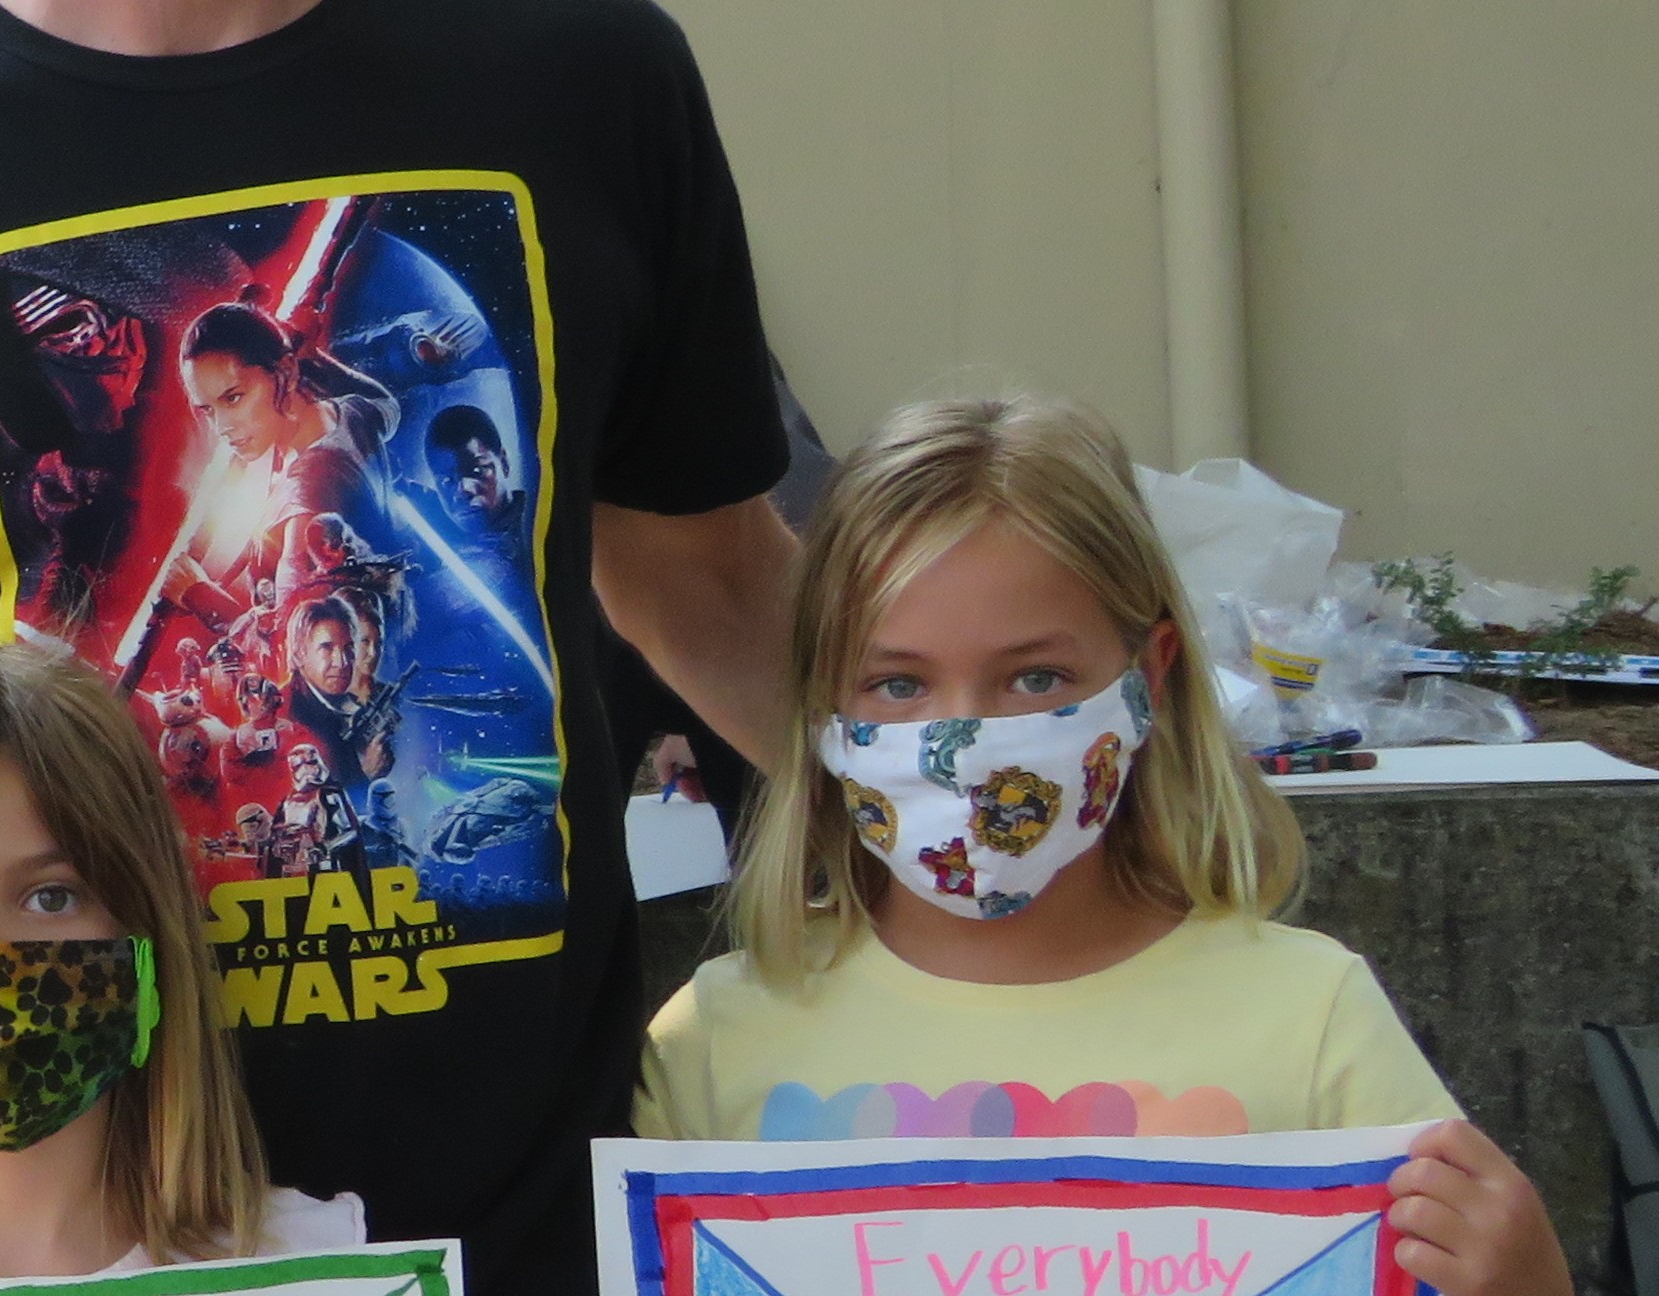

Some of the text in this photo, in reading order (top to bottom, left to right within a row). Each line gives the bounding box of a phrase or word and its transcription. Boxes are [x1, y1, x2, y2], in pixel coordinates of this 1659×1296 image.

[206, 865, 438, 944] STAR
[237, 923, 457, 962] FORCE AWAKENS
[217, 940, 513, 1029] WARS
